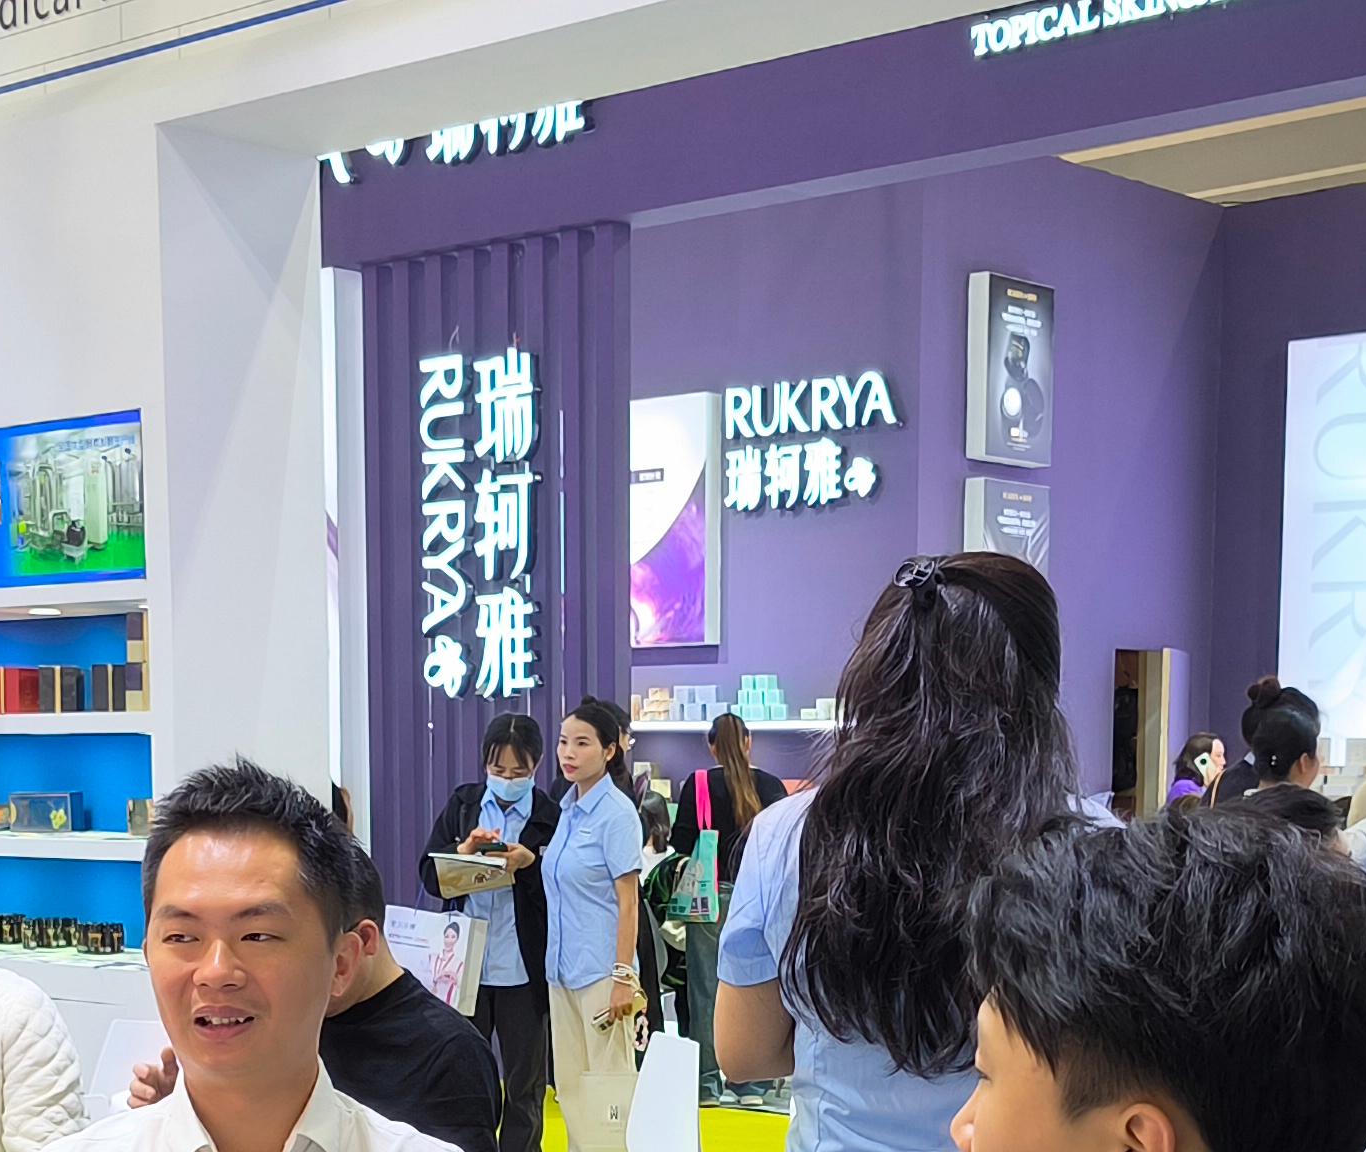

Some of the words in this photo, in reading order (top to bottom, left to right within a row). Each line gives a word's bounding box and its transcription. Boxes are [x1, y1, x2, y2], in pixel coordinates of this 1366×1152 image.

[969, 0, 1102, 57] TOPICAL
[724, 369, 898, 441] RUKRYA
[419, 353, 467, 636] RUKRYA
